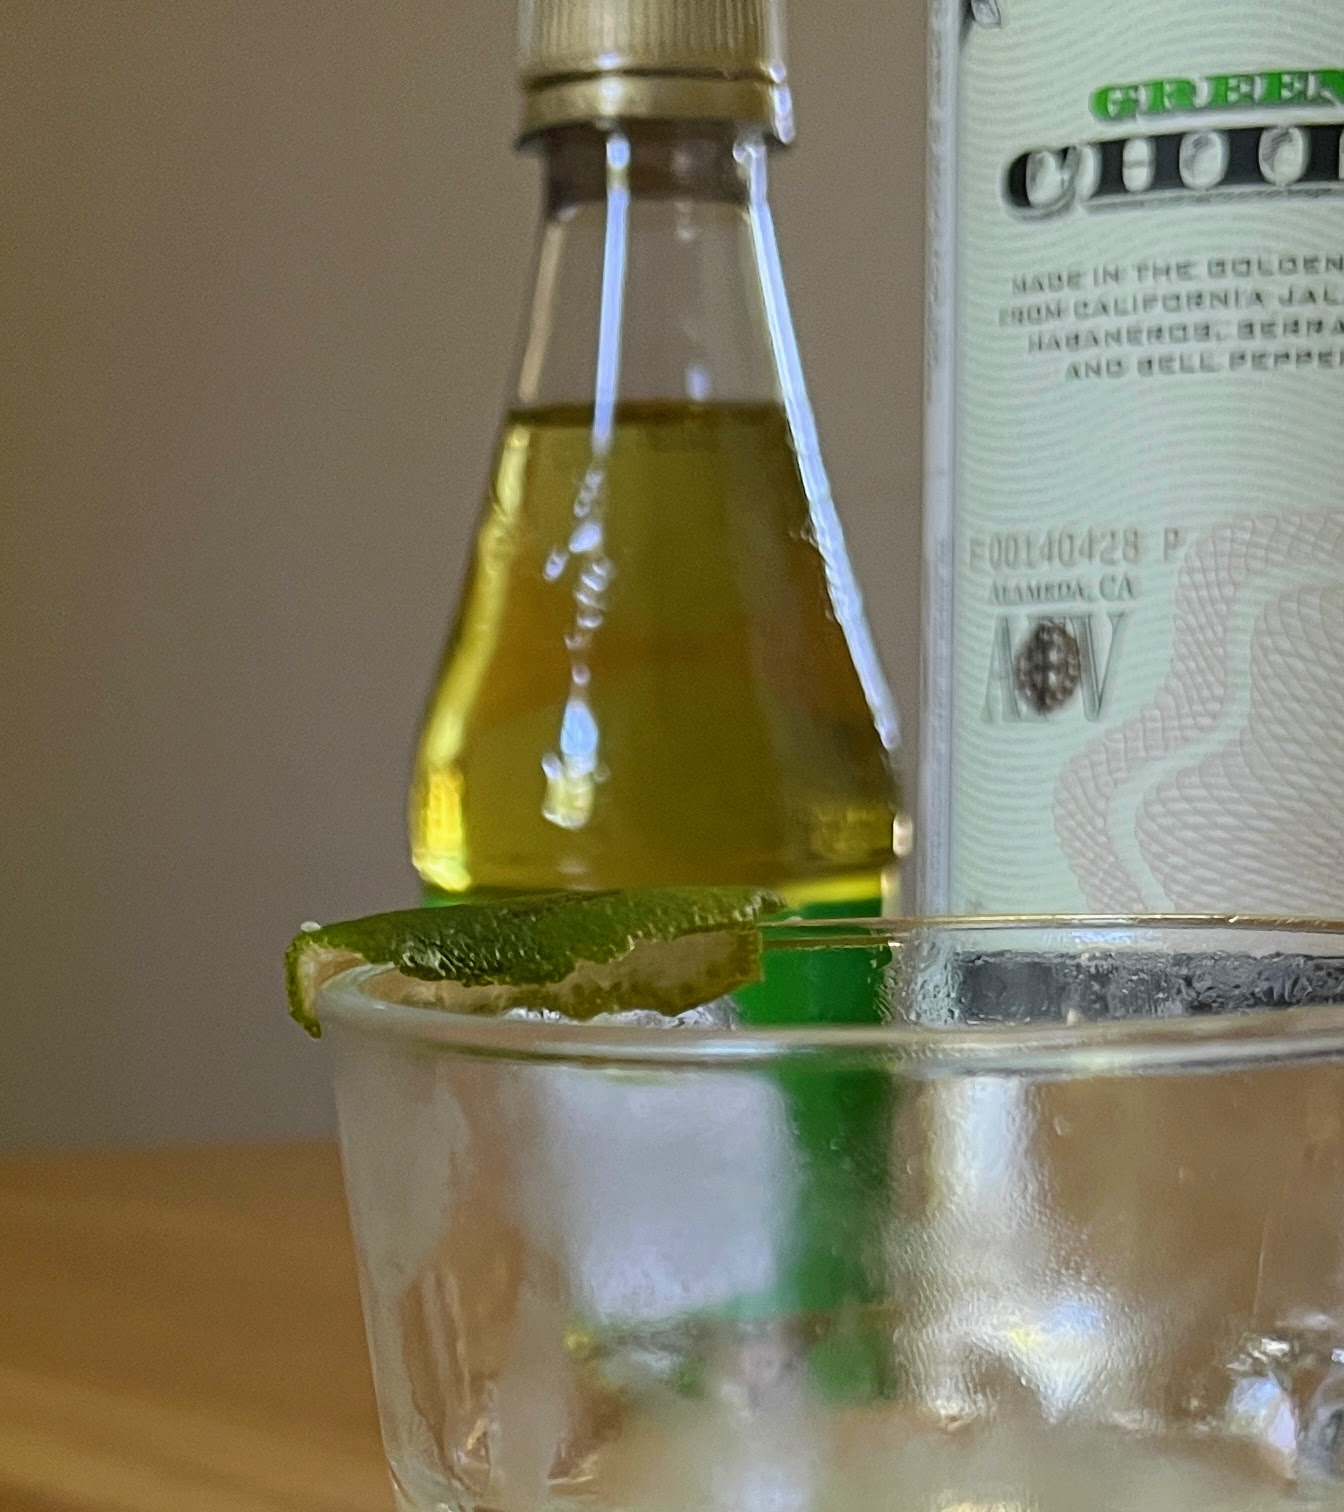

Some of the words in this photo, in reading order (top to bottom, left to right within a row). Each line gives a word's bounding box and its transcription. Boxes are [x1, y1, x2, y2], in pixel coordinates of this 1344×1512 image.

[1011, 267, 1082, 296] MADE
[1093, 262, 1124, 288] IN
[1133, 257, 1193, 283] THE
[1206, 253, 1344, 280] GOLDEN
[998, 298, 1064, 328] FROM
[1073, 285, 1266, 321] CALIFORNIA
[1027, 322, 1222, 353] HABANEROS,
[1064, 357, 1128, 383] AND
[1136, 350, 1222, 378] BELL
[1163, 527, 1183, 562] P
[990, 580, 1096, 605] ALAMEDA,
[1099, 571, 1137, 601] CA
